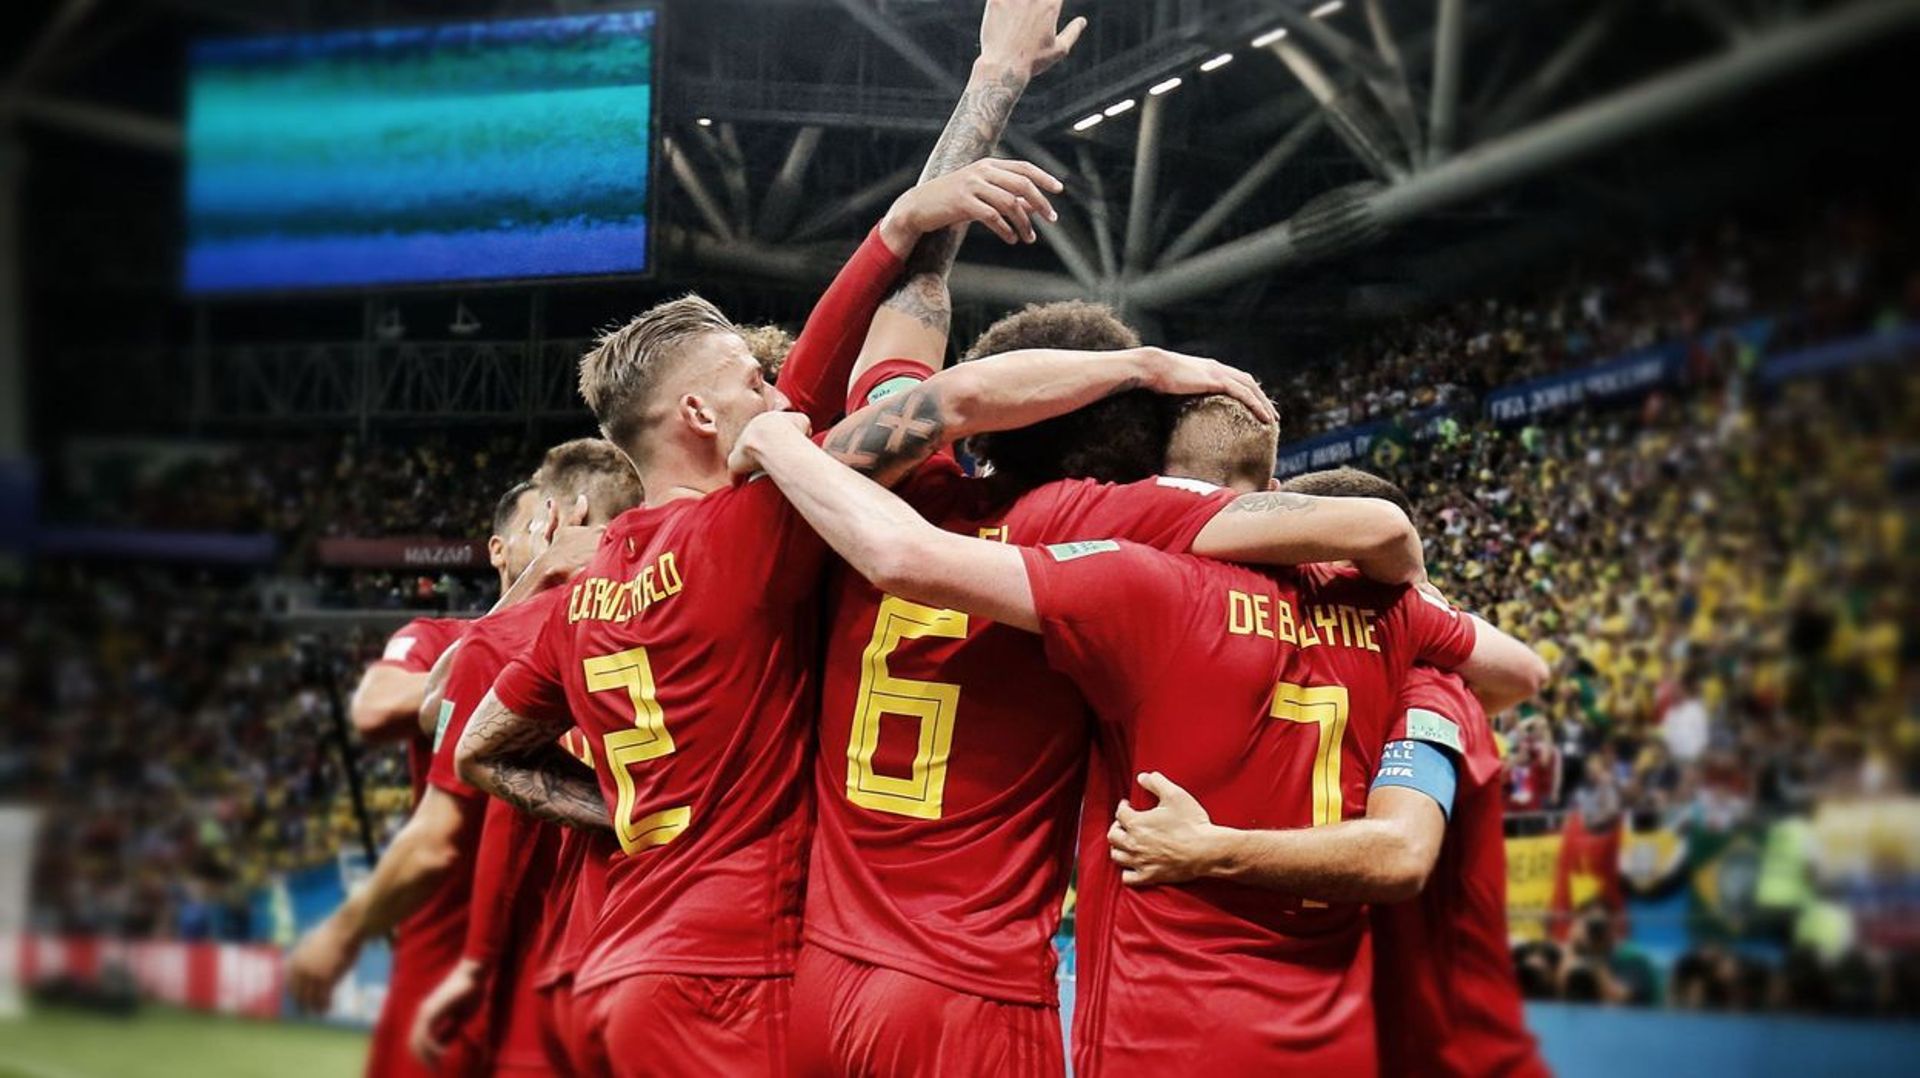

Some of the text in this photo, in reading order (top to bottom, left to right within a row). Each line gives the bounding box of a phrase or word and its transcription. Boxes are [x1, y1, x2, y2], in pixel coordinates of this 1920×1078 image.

[1228, 590, 1381, 653] DE BUYNE
[583, 646, 691, 857] 2
[846, 593, 968, 820] 6
[1269, 681, 1348, 828] 7
[1378, 767, 1413, 777] FIFA
